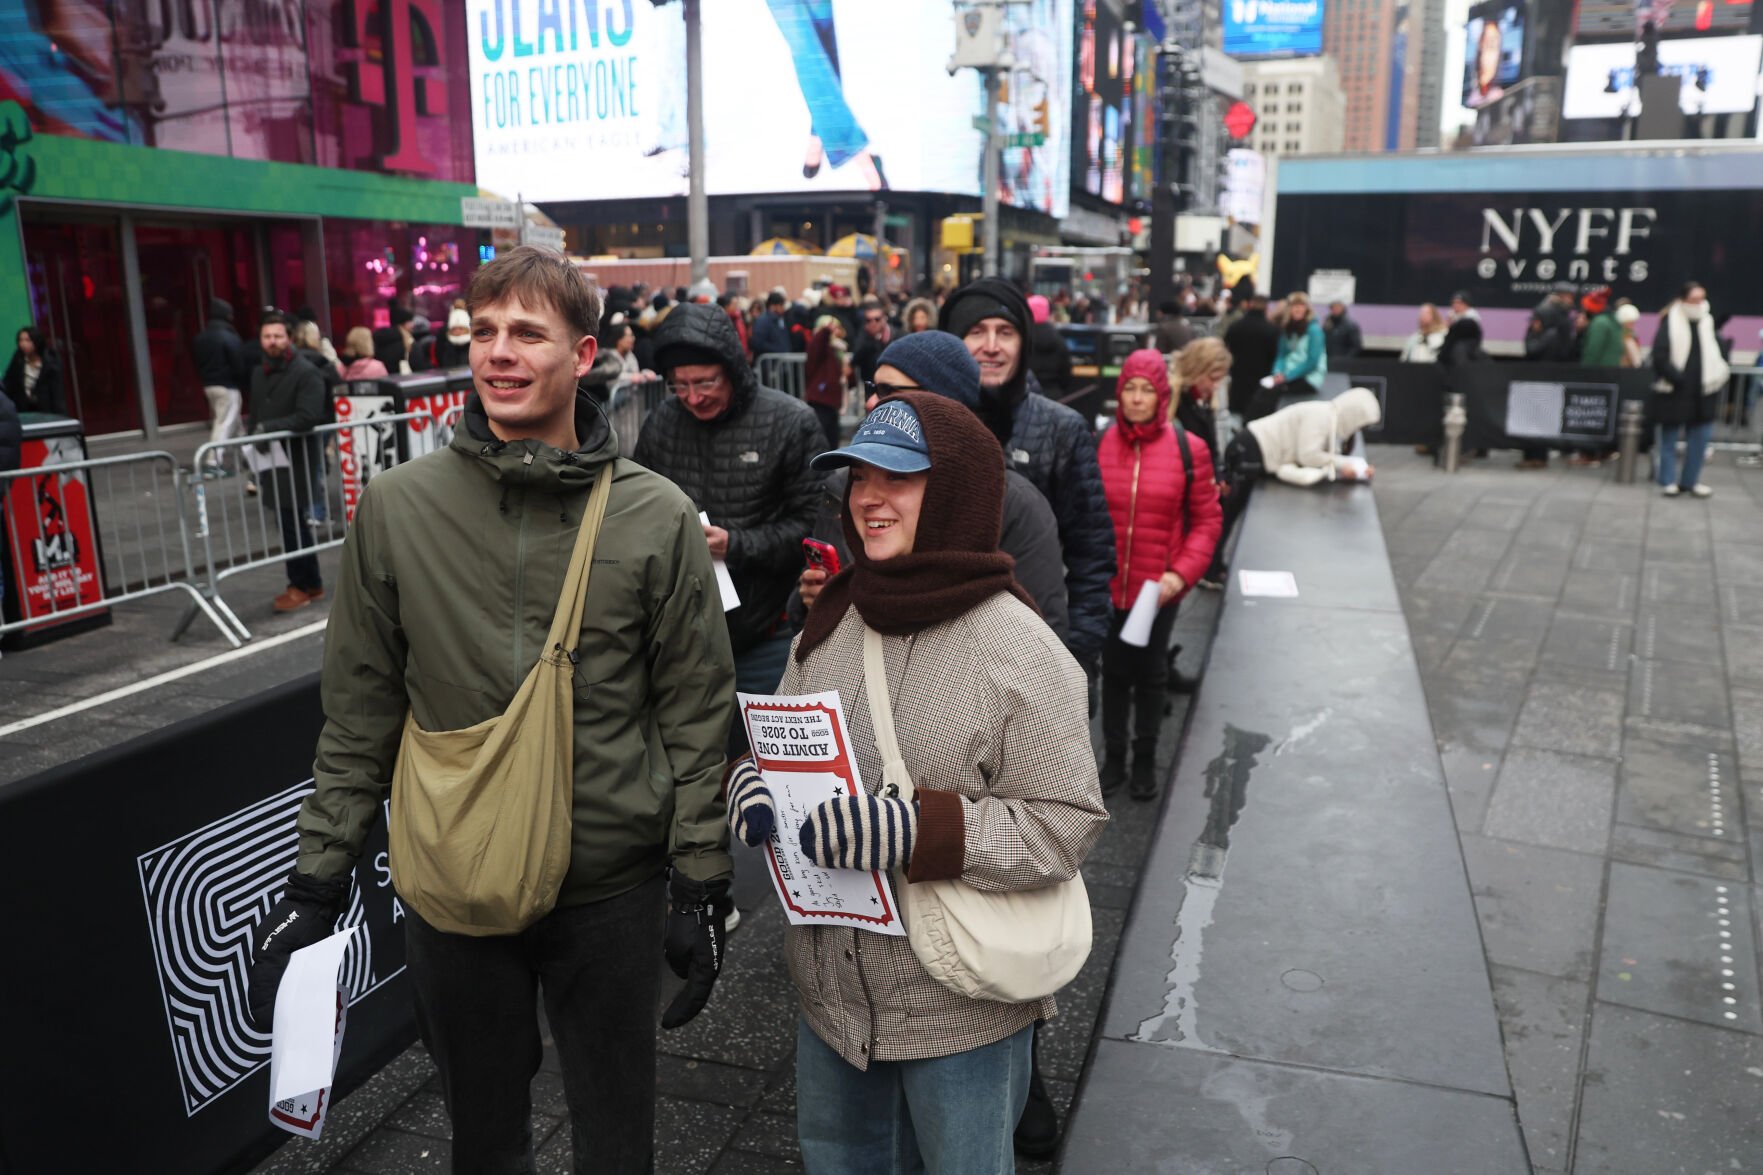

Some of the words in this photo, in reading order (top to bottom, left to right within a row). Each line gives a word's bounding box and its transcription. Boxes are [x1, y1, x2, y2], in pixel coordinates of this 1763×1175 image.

[482, 70, 521, 129] FOR
[528, 56, 640, 126] EVERYONE
[487, 136, 578, 156] AMERICAN
[1480, 208, 1658, 254] NYFF
[1477, 256, 1650, 282] events
[771, 715, 784, 724] ACT
[785, 715, 803, 724] NEXT
[803, 714, 822, 724] THE
[761, 726, 787, 740] 2026
[788, 727, 808, 740] TO
[757, 741, 780, 757] ONE
[782, 743, 829, 757] ADMIT
[773, 846, 791, 881] GOOD
